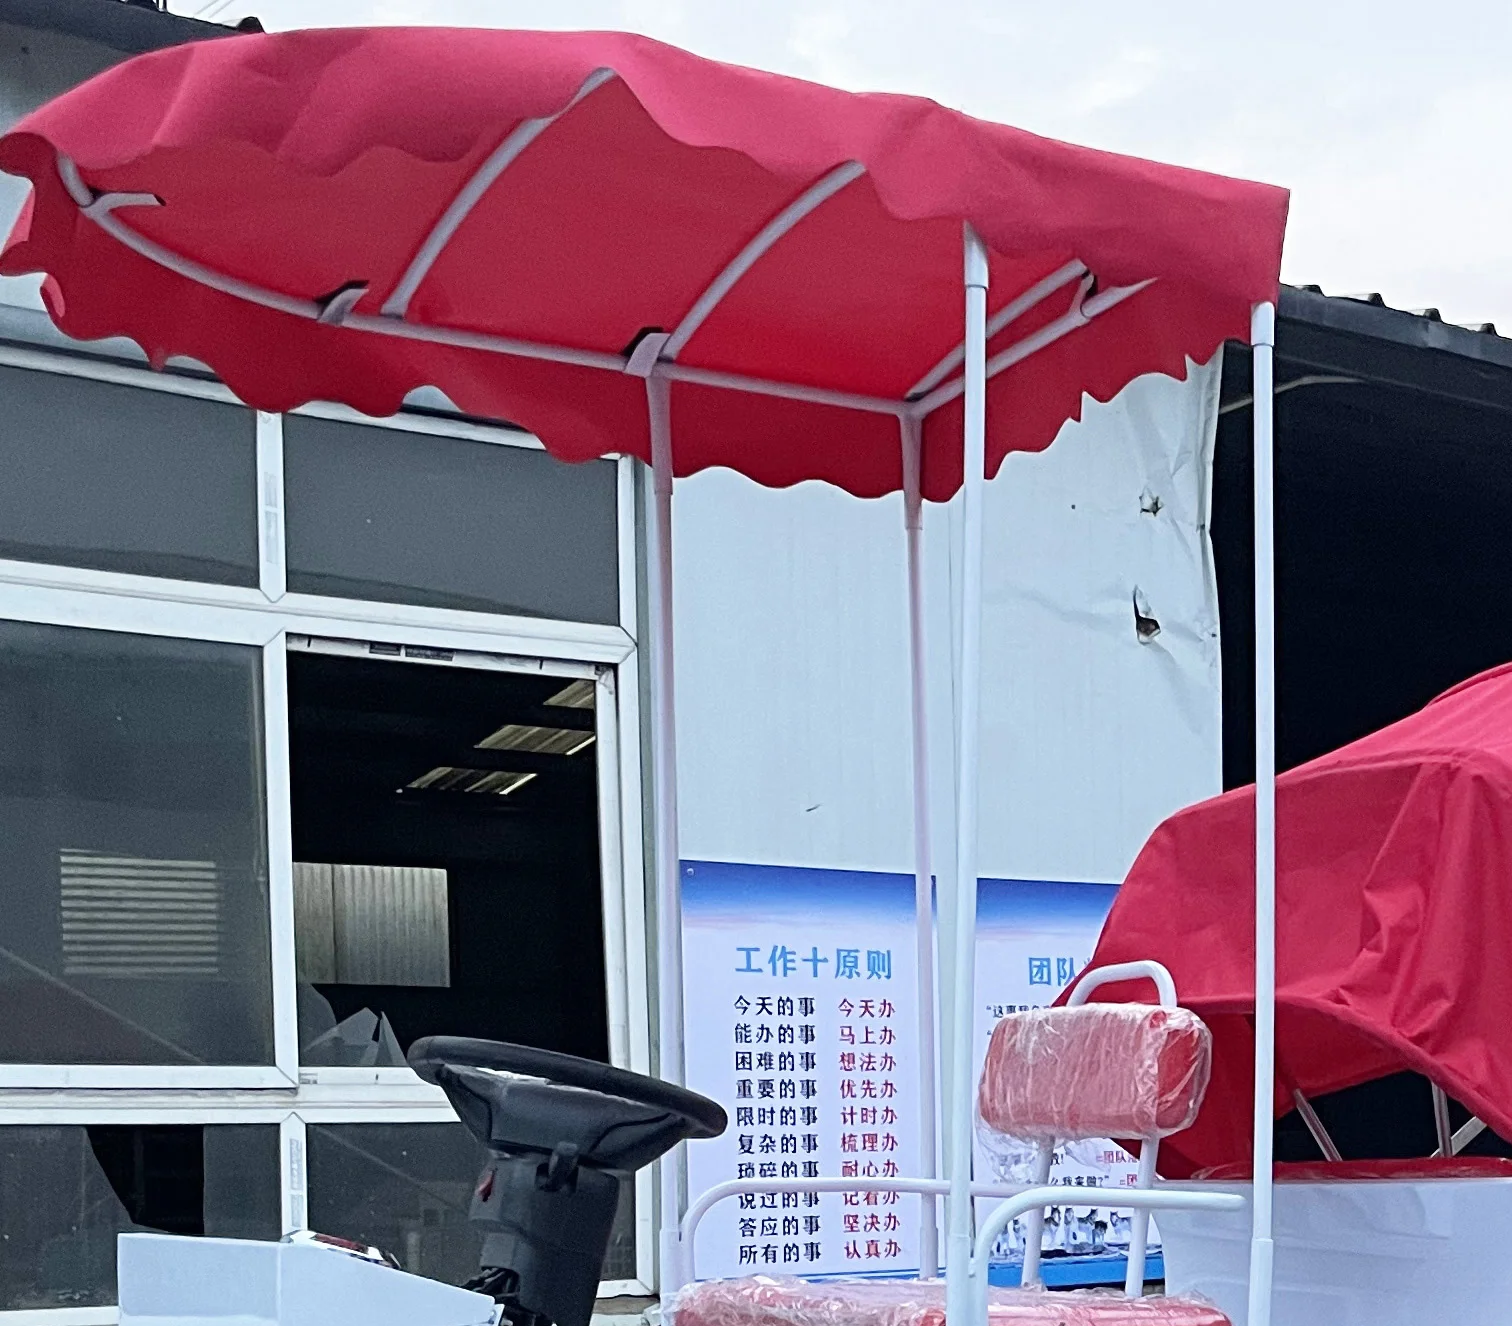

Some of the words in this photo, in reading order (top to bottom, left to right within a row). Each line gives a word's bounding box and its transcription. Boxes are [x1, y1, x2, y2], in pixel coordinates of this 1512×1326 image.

[735, 945, 892, 980] 工作十原则
[733, 995, 815, 1017] 今天的事
[838, 998, 895, 1018] 今天办
[734, 1023, 816, 1044] 能办的事
[839, 1026, 896, 1045] 马上办
[735, 1051, 816, 1072] 困难的事
[839, 1052, 897, 1072] 想法办
[736, 1079, 817, 1099] 重要的事
[840, 1079, 897, 1099] 优先办
[736, 1106, 818, 1126] 限时的事
[840, 1106, 898, 1125] 计时办
[738, 1134, 819, 1154] 复杂的事
[841, 1132, 898, 1153] 梳理办
[737, 1161, 819, 1179] 琐碎的事
[842, 1159, 899, 1178] 耐心办
[738, 1191, 820, 1210] 说过的事
[739, 1215, 821, 1237] 答应的事
[844, 1212, 901, 1233] 坚决办
[739, 1242, 821, 1265] 所有的事
[845, 1239, 902, 1259] 认真办
